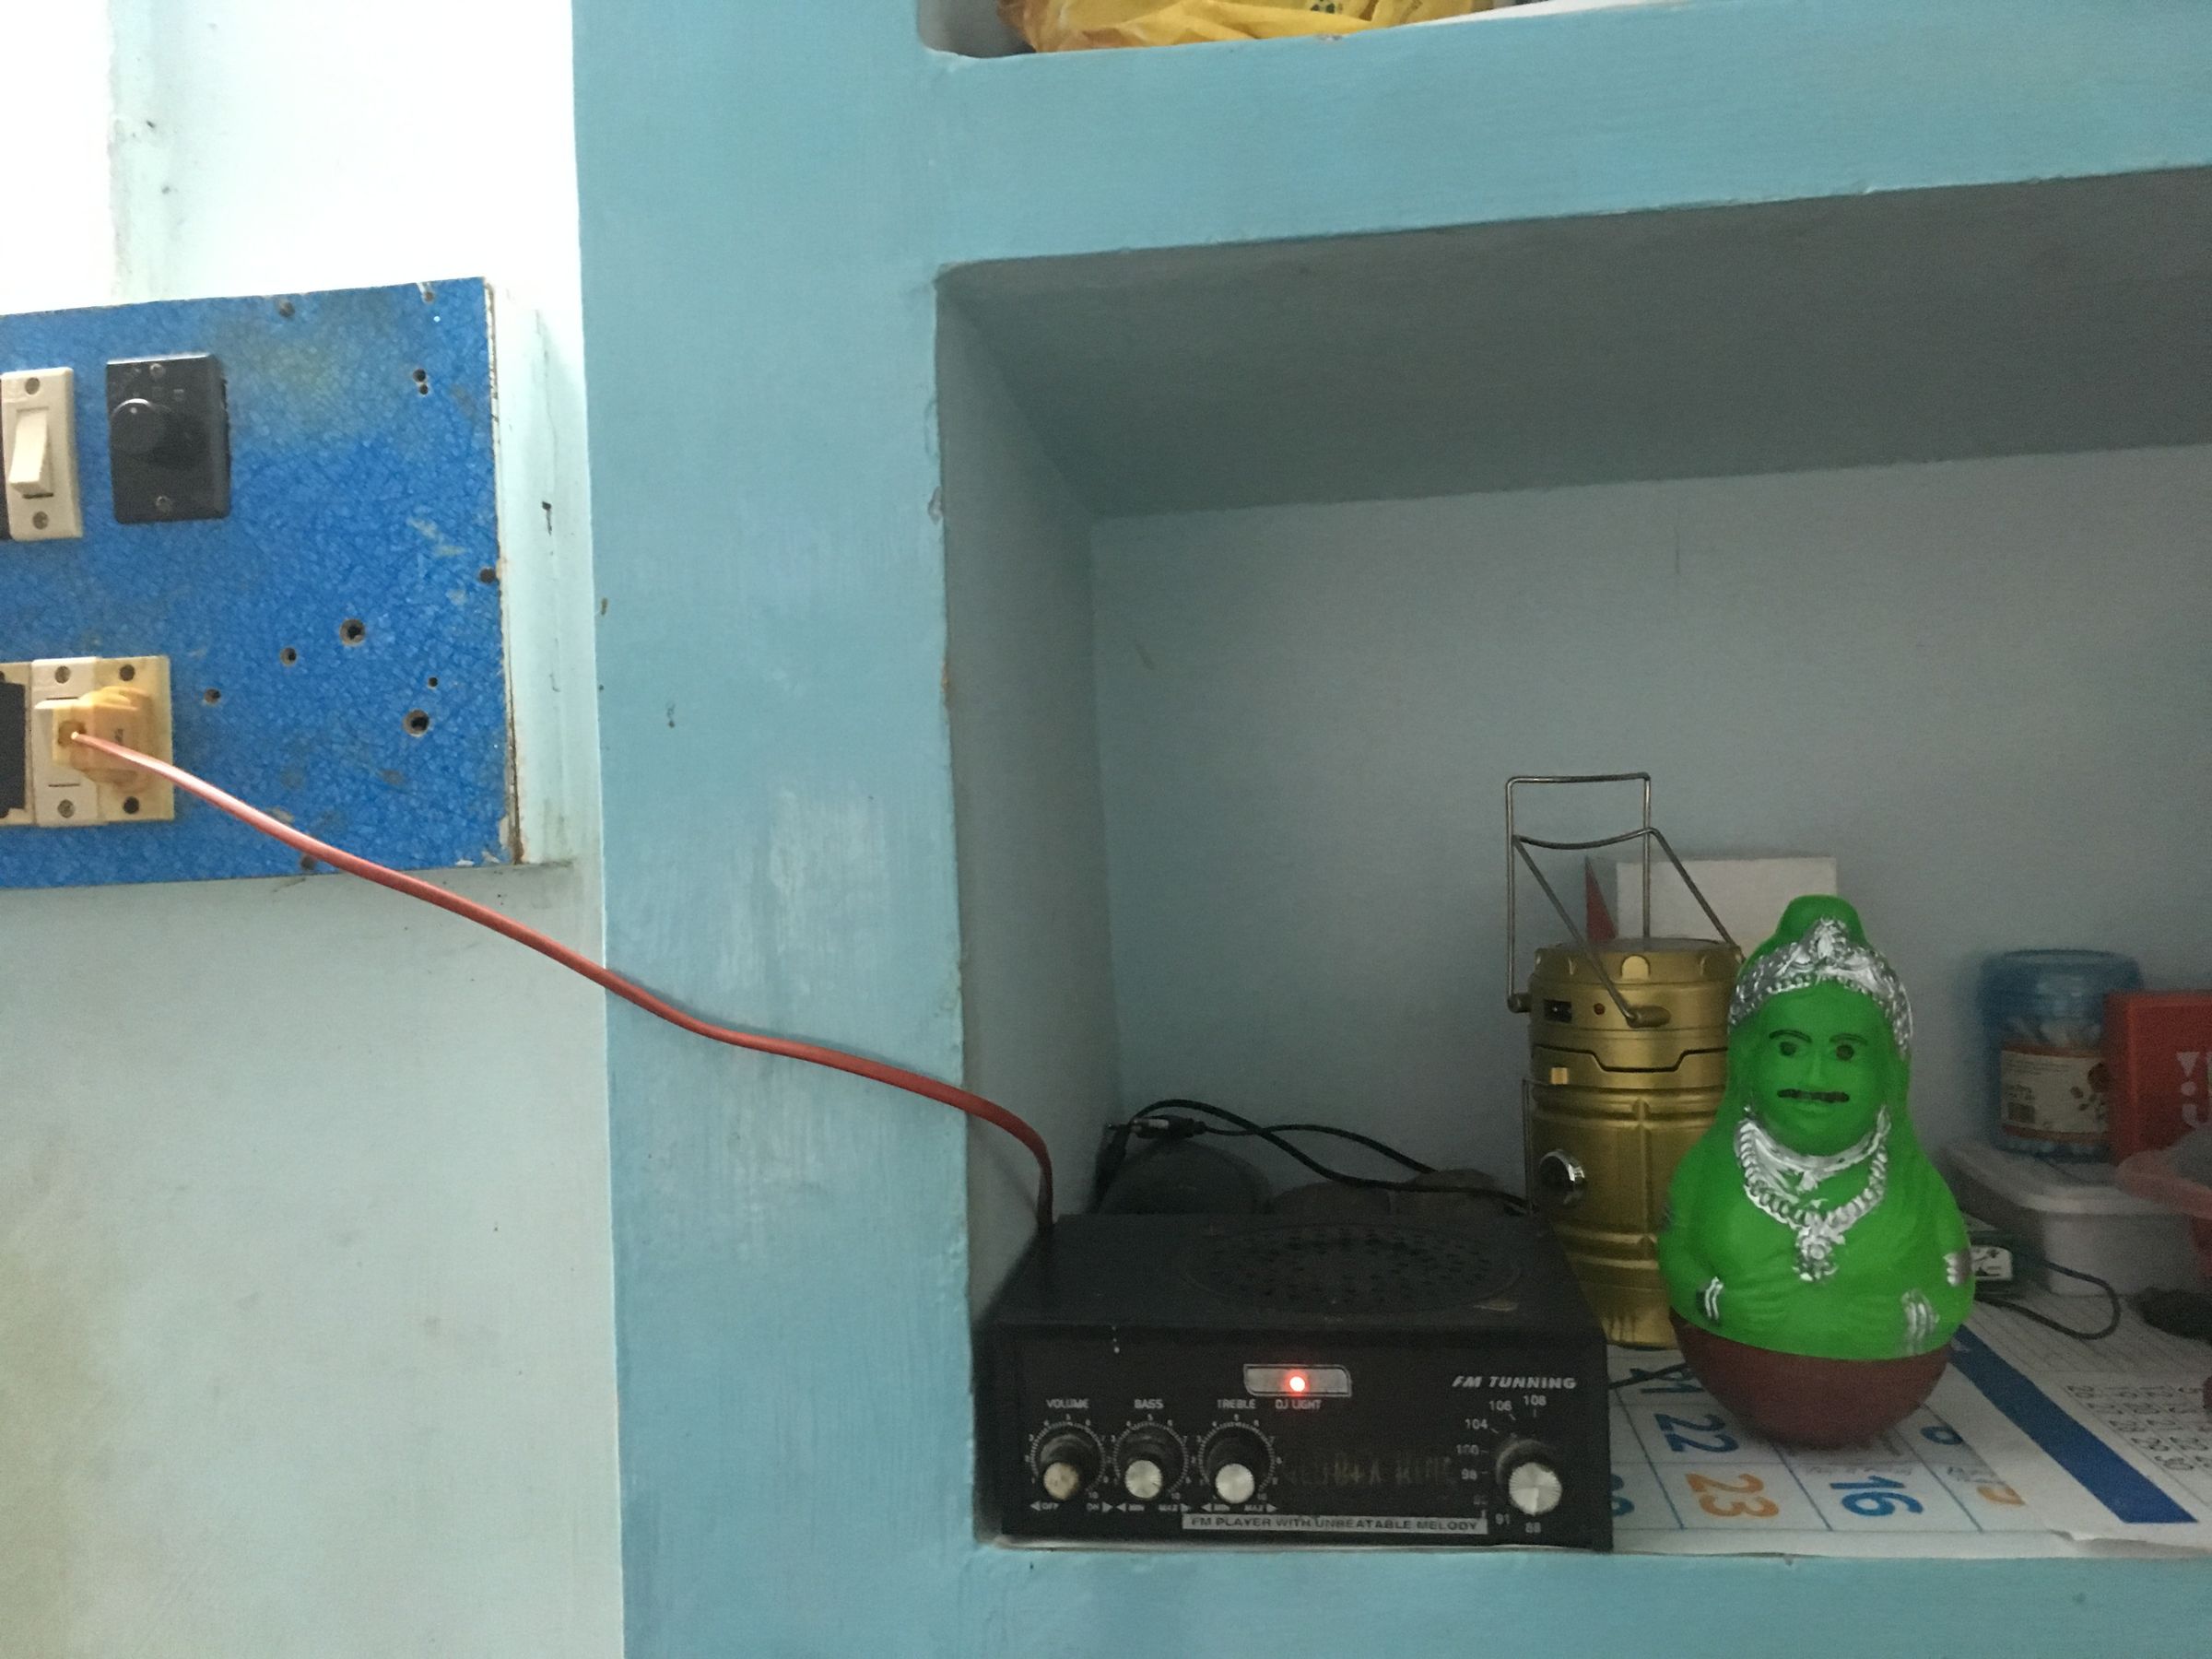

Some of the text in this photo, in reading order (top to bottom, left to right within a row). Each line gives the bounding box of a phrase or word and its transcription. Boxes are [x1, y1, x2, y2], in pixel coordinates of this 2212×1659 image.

[1452, 1376, 1577, 1389] FM TUNNING
[1046, 1398, 1089, 1409] VOLUME
[1134, 1398, 1165, 1409] BASS
[1217, 1398, 1256, 1409] TREBLE
[1275, 1399, 1322, 1410] DJ LIGHT
[1488, 1400, 1512, 1412] 106
[1523, 1394, 1547, 1406] 108
[1465, 1418, 1488, 1430] 104
[1653, 1412, 1740, 1453] 22
[1685, 1472, 1780, 1518] 23
[1829, 1475, 1924, 1518] 16
[1191, 1517, 1477, 1531] FM PLAYER WITH UNBEATABLE MELODY
